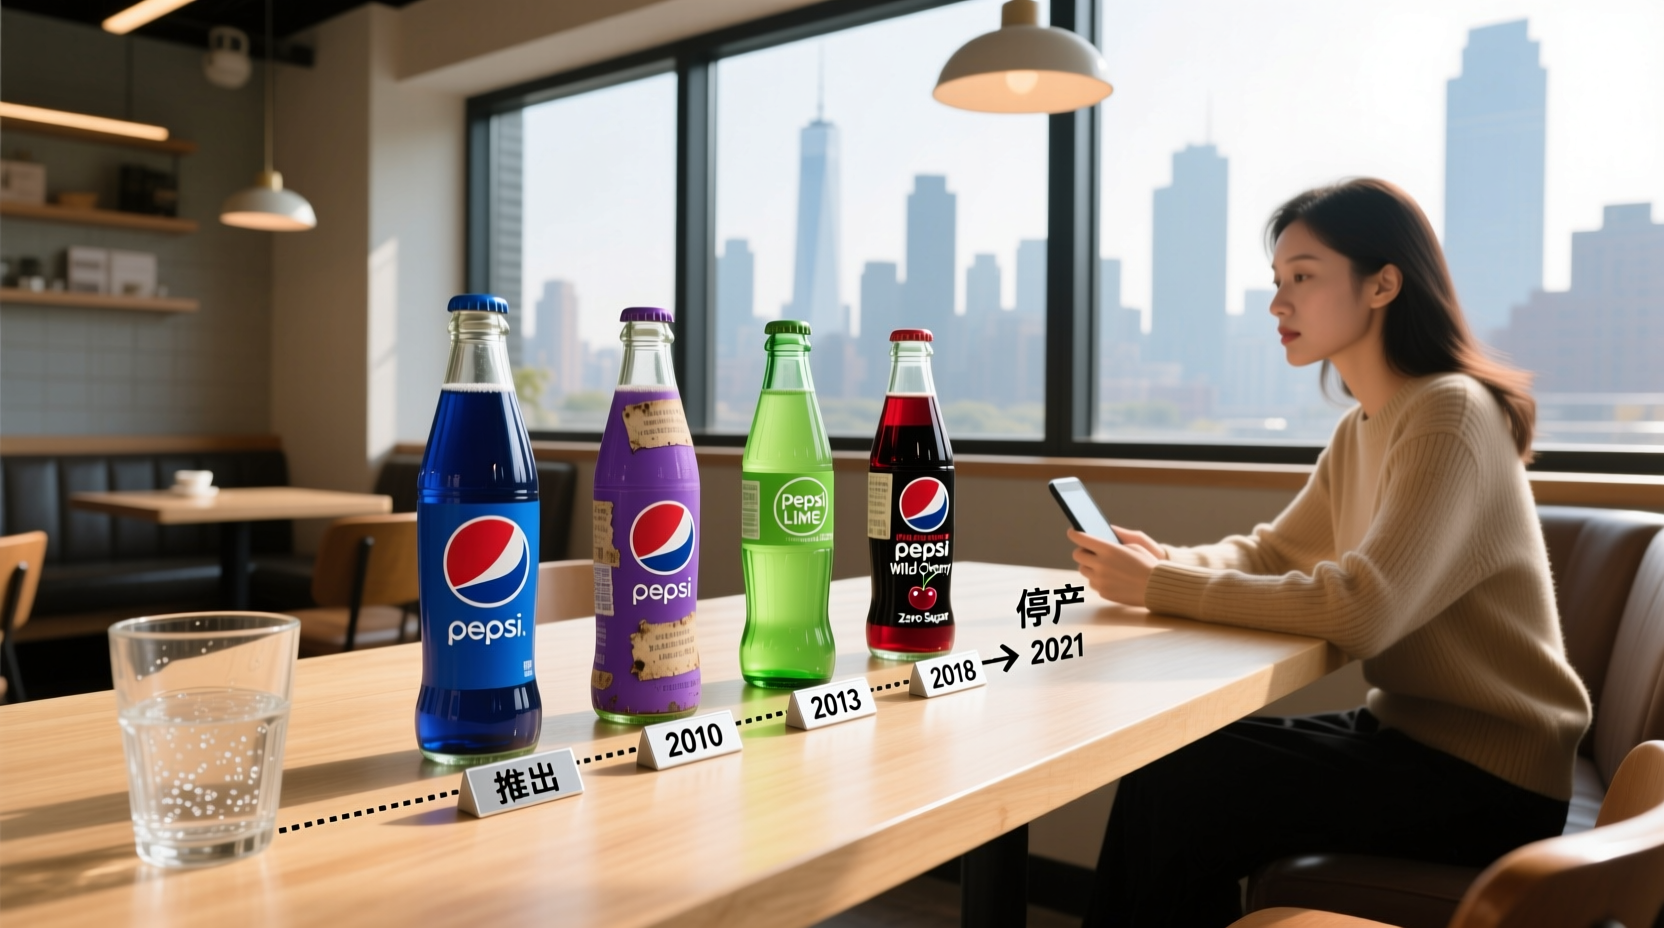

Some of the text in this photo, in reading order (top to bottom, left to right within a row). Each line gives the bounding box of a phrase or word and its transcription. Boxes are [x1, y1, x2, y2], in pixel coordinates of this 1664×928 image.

[783, 510, 821, 525] LIME
[895, 540, 949, 561] pepsi
[632, 576, 691, 605] pepsi
[1016, 583, 1085, 629] 停产
[1030, 632, 1084, 665] 2021
[930, 659, 977, 689] 2018
[811, 688, 862, 720] 2013
[665, 723, 723, 758] 2010
[494, 762, 560, 805] 推出
